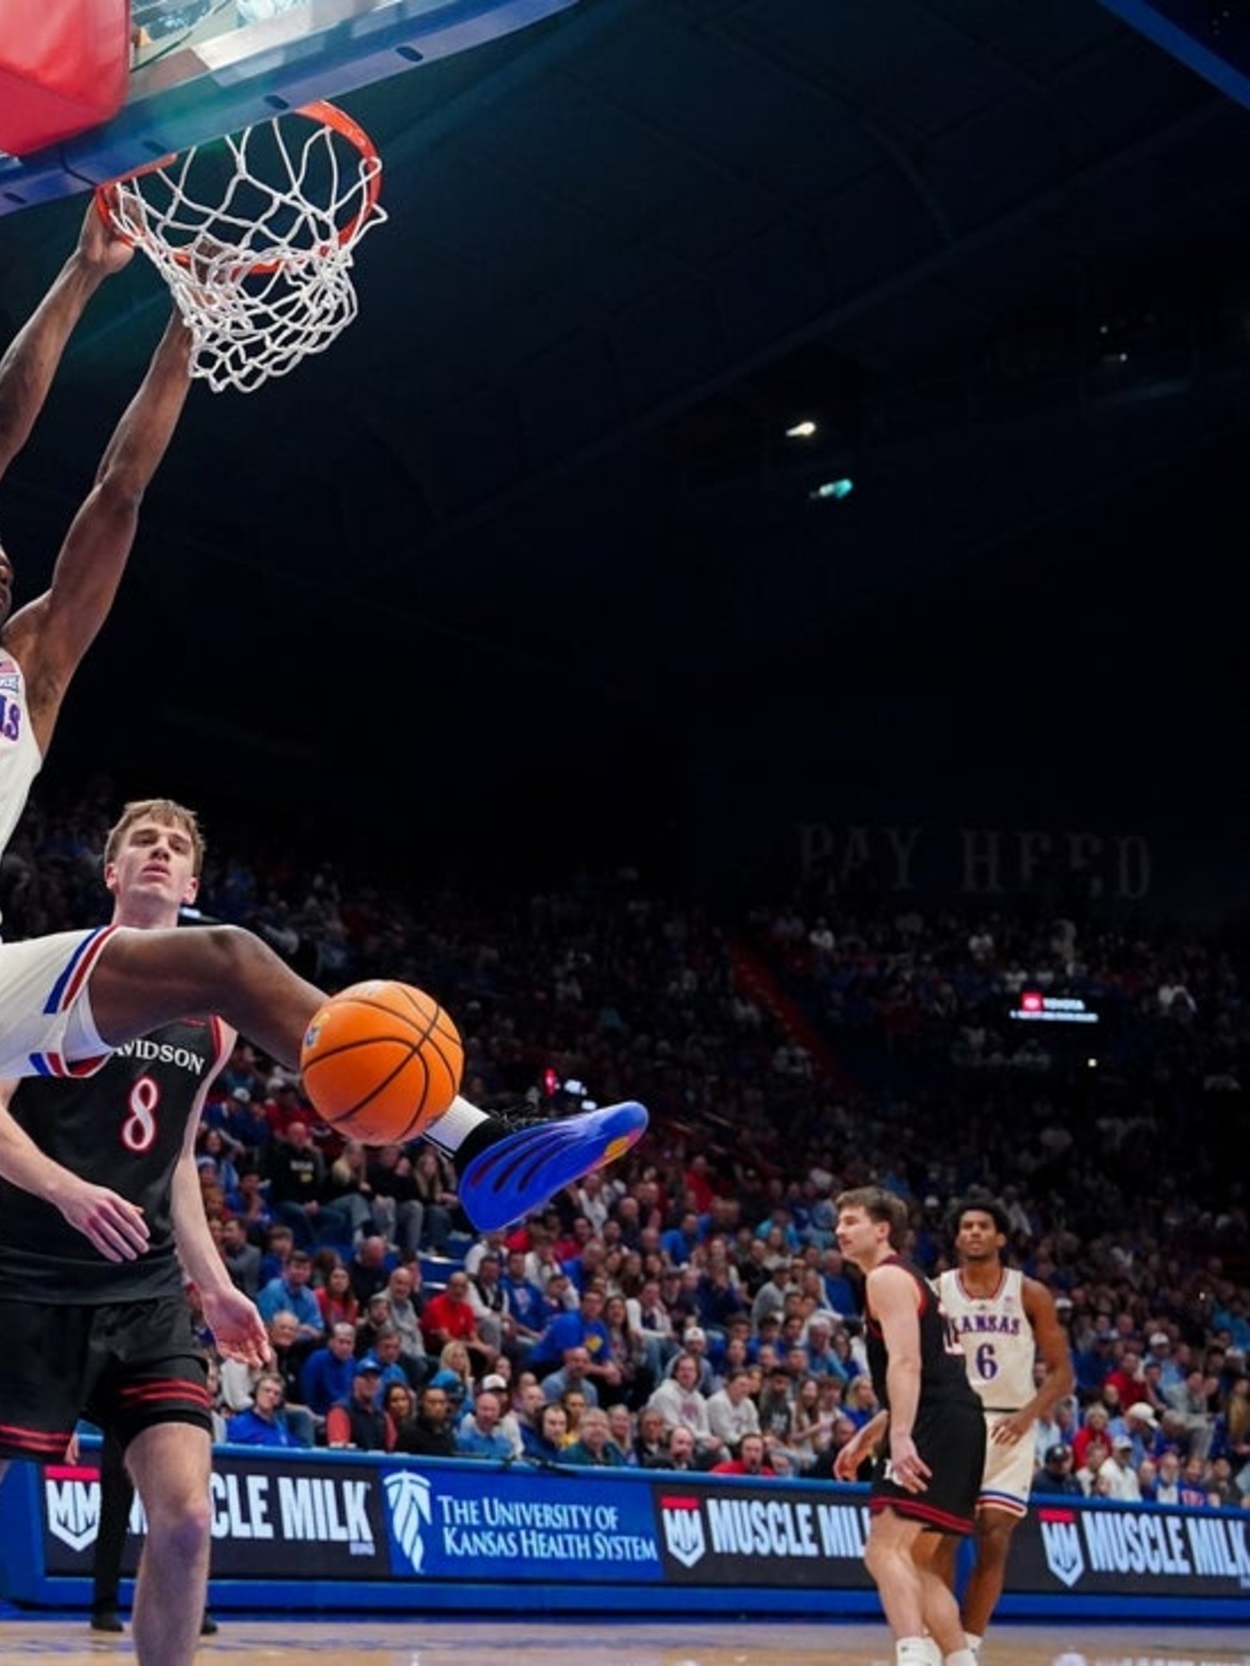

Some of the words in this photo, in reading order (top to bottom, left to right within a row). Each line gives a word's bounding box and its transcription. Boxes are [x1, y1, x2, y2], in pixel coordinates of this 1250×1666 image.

[119, 1074, 160, 1156] 8
[976, 1343, 998, 1380] 6
[277, 1477, 374, 1542] MILK
[706, 1498, 819, 1557] MUSCLE
[1081, 1510, 1192, 1576] MUSCLE
[1185, 1516, 1250, 1578] MILK
